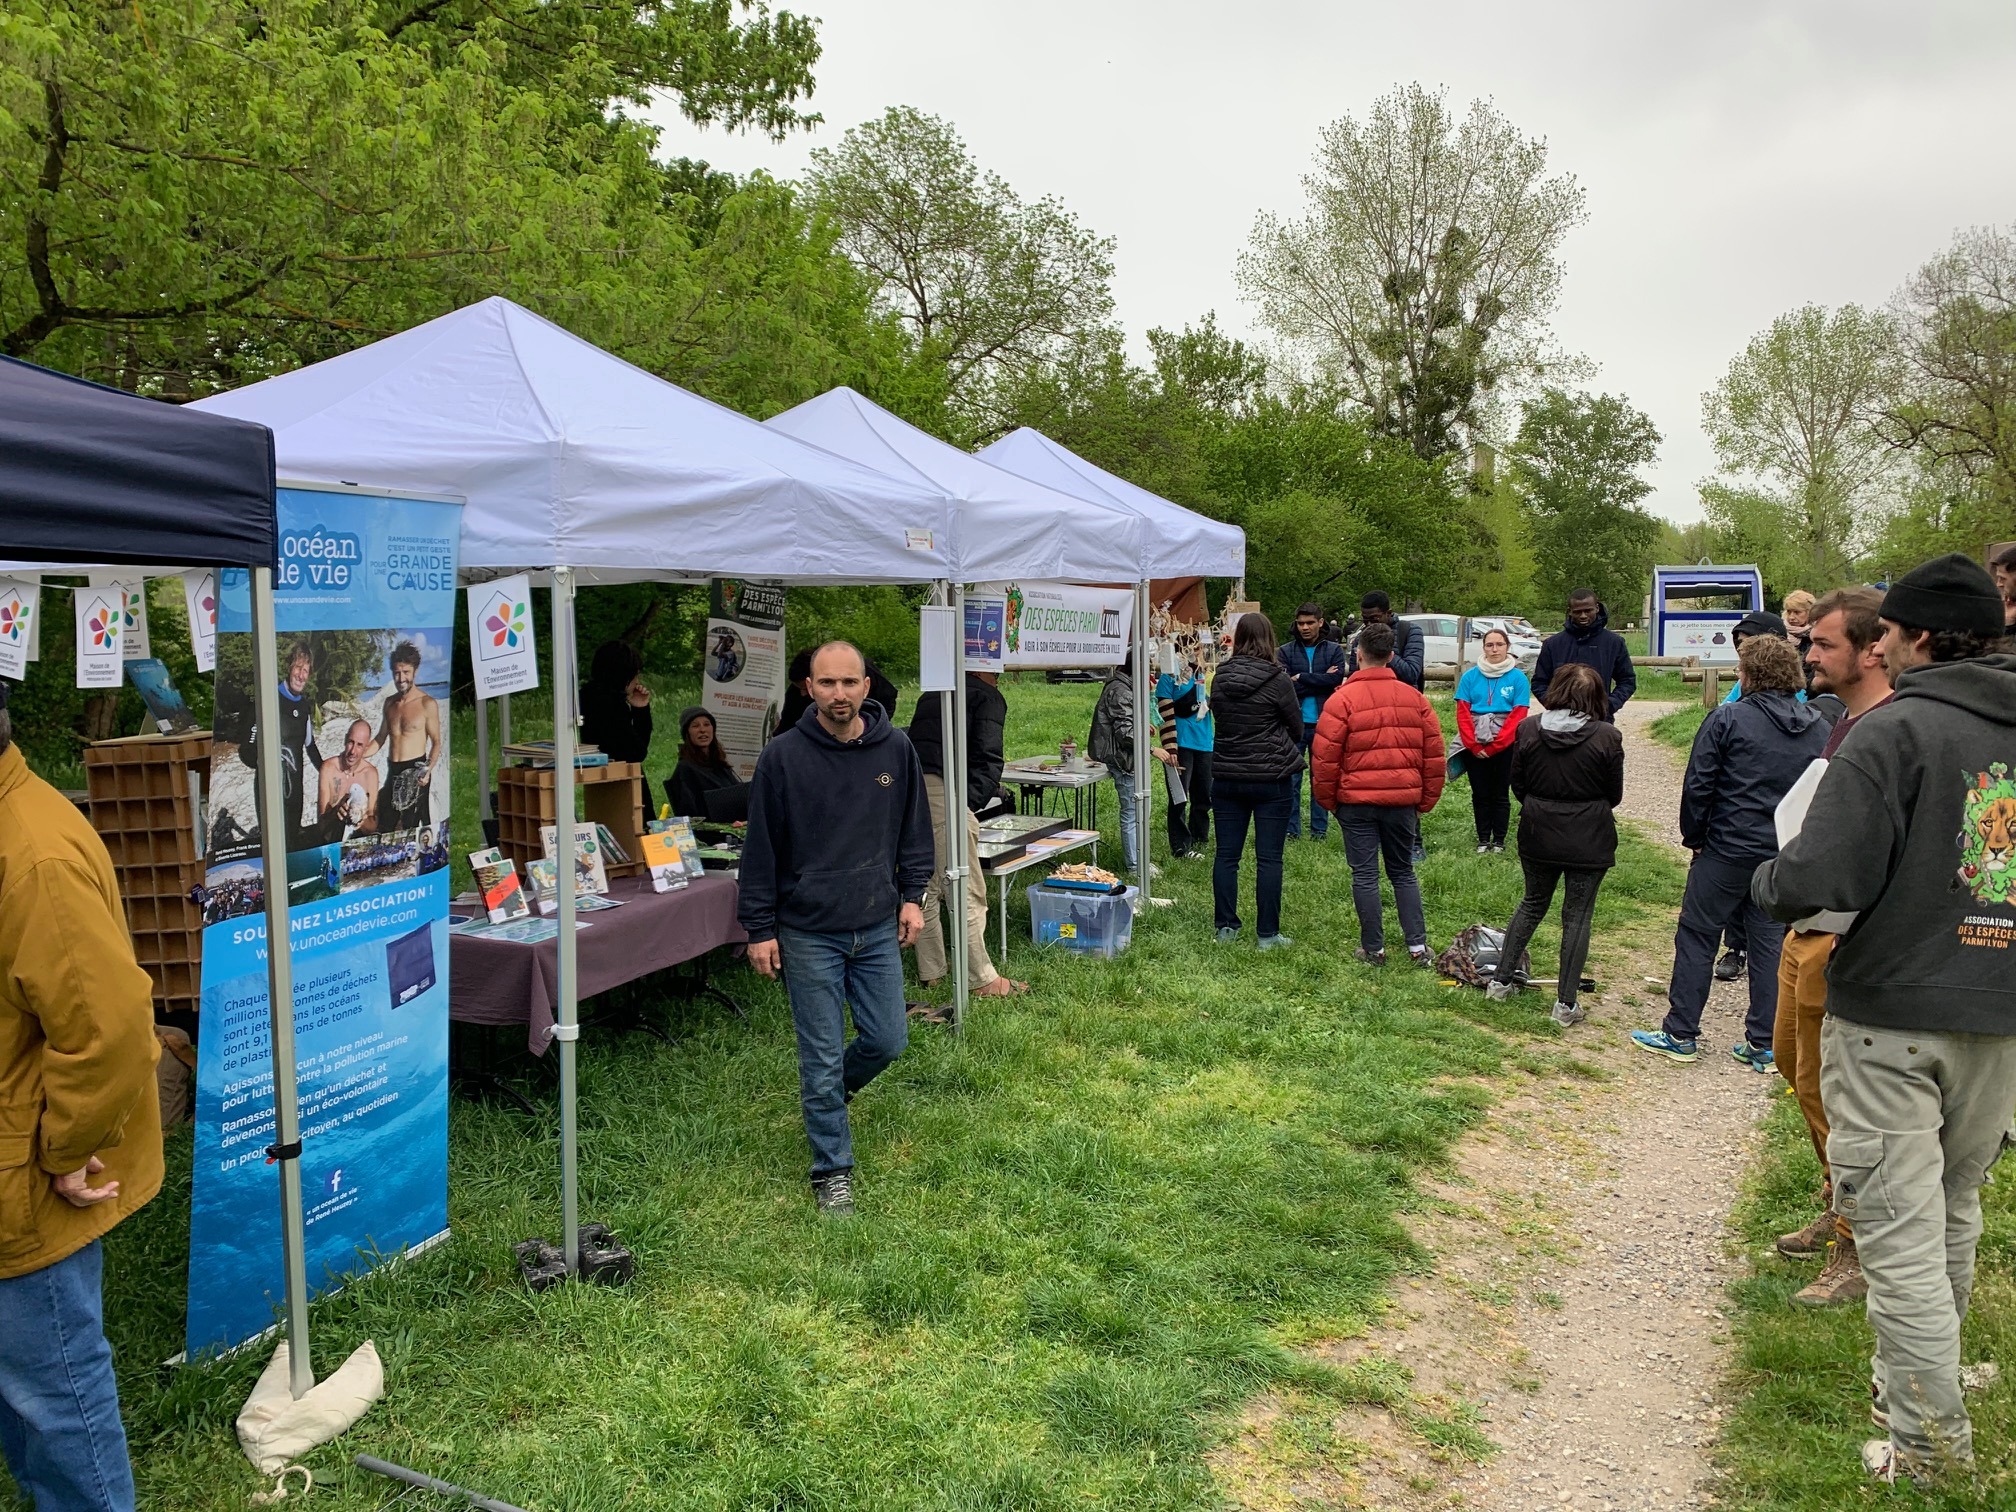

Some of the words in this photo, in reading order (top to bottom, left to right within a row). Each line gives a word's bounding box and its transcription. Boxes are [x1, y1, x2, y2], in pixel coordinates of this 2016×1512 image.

[283, 531, 357, 559] océan
[308, 560, 348, 584] vie
[387, 554, 452, 570] GRANDE
[387, 571, 452, 591] CAUSE
[743, 589, 759, 600] DES
[761, 592, 785, 607] ESPÈCE
[1024, 607, 1043, 630] DES
[1044, 603, 1078, 632] ESPÈCES
[1101, 613, 1119, 636] LYON
[1040, 641, 1048, 652] SON
[234, 914, 320, 944] SOUNEZ
[326, 887, 426, 922] L'ASSOCIATION
[1957, 925, 1974, 936] DES
[1964, 916, 2014, 928] ASSOCIATION
[1961, 936, 2009, 949] PARMI'LYON
[223, 1007, 268, 1027] millions
[327, 985, 340, 996] de
[342, 972, 377, 992] déchets
[224, 993, 268, 1012] Chaque
[309, 968, 351, 992] plusieurs
[223, 1025, 248, 1042] sont
[312, 1005, 326, 1016] les
[328, 991, 360, 1009] océans
[223, 1040, 249, 1057] dont
[253, 1033, 268, 1047] 9,1
[317, 1016, 329, 1027] de
[332, 1004, 363, 1023] tonnes
[222, 1071, 274, 1095] Agissons
[319, 1052, 324, 1062] à
[326, 1044, 352, 1059] notre
[354, 1031, 384, 1048] niveau
[222, 1095, 248, 1112] pour
[323, 1064, 332, 1075] la
[334, 1046, 375, 1072] pollution
[377, 1034, 408, 1052] marine
[223, 1060, 237, 1071] de
[314, 1083, 342, 1100] qu'un
[344, 1067, 375, 1087] déchet
[377, 1062, 387, 1073] et
[221, 1121, 276, 1148] devenons
[307, 1104, 320, 1116] un
[322, 1075, 388, 1109] éco-volontaire
[221, 1159, 236, 1171] Un
[342, 1111, 354, 1123] au
[355, 1091, 399, 1117] quotidien
